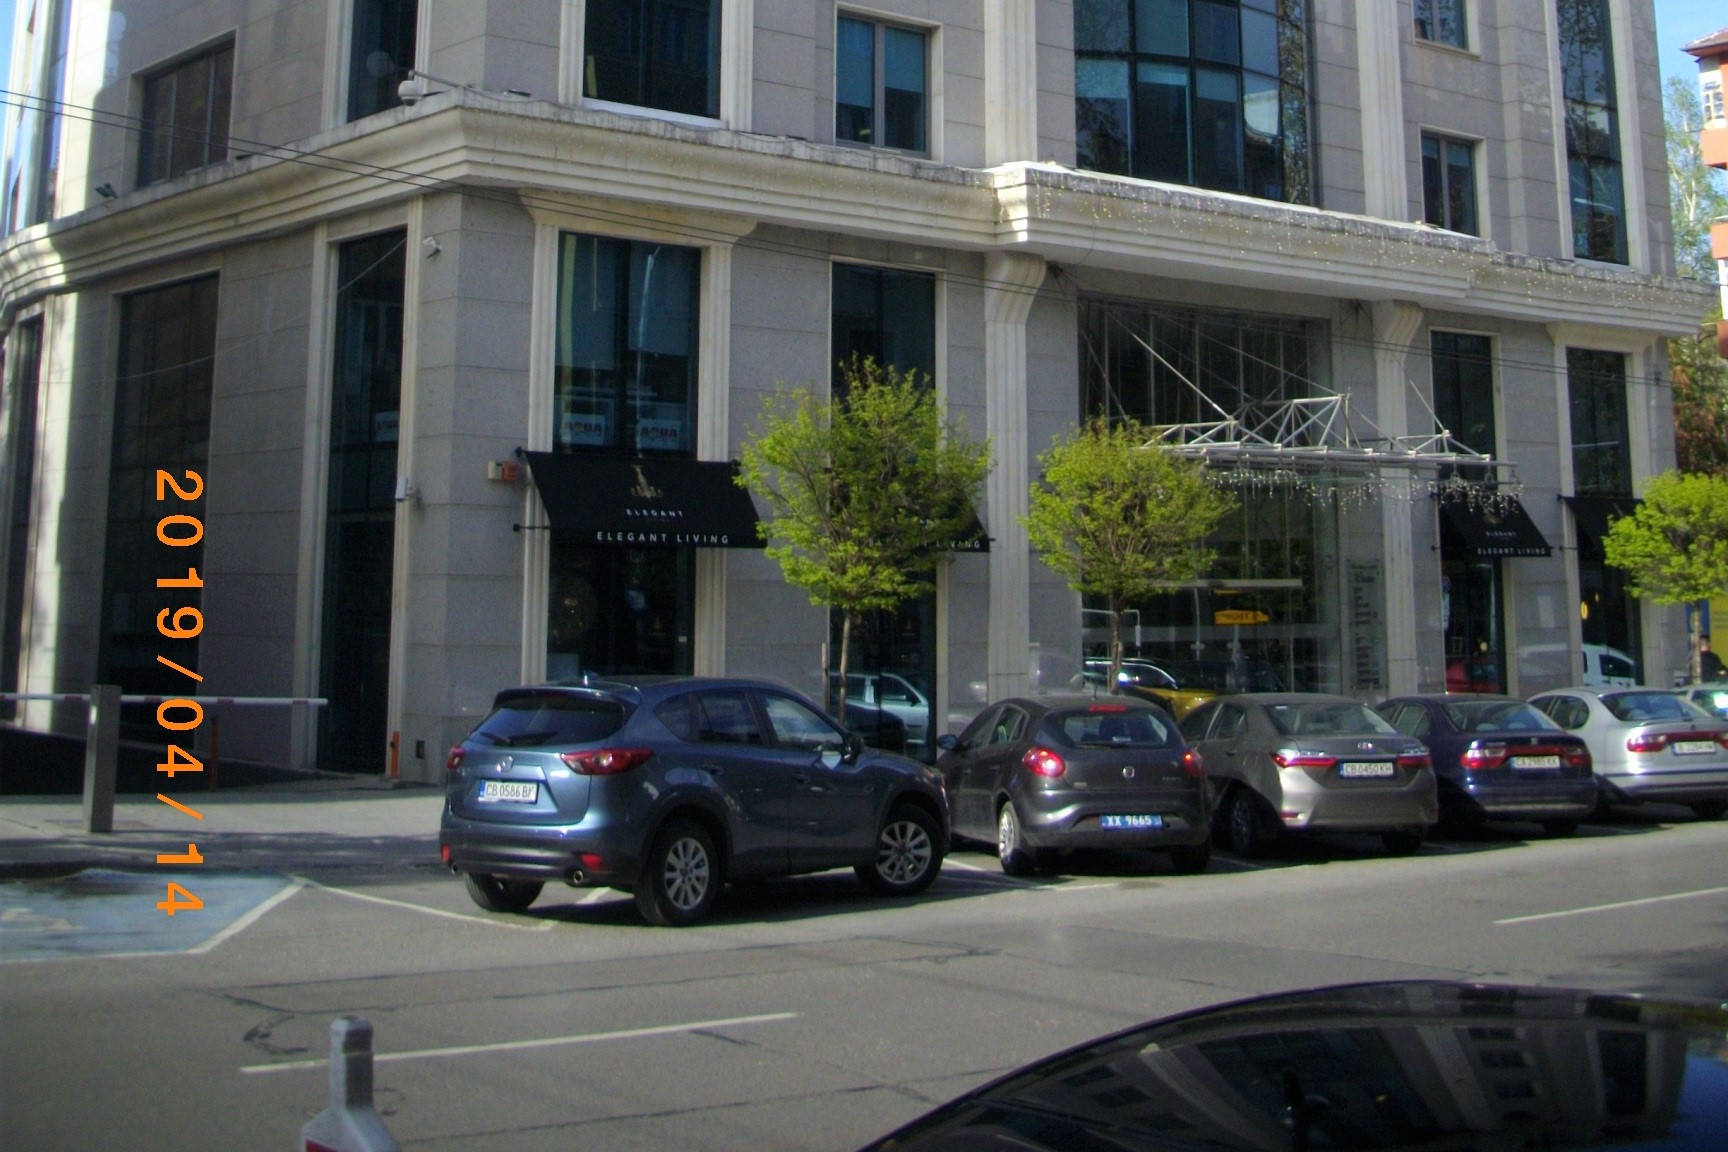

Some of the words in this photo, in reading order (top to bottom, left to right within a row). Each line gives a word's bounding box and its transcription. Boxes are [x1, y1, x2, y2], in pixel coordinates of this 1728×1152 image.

[626, 508, 684, 517] ELEGANT
[596, 530, 668, 543] ELEGANT
[676, 532, 730, 545] LIVING
[1125, 814, 1152, 826] 9665
